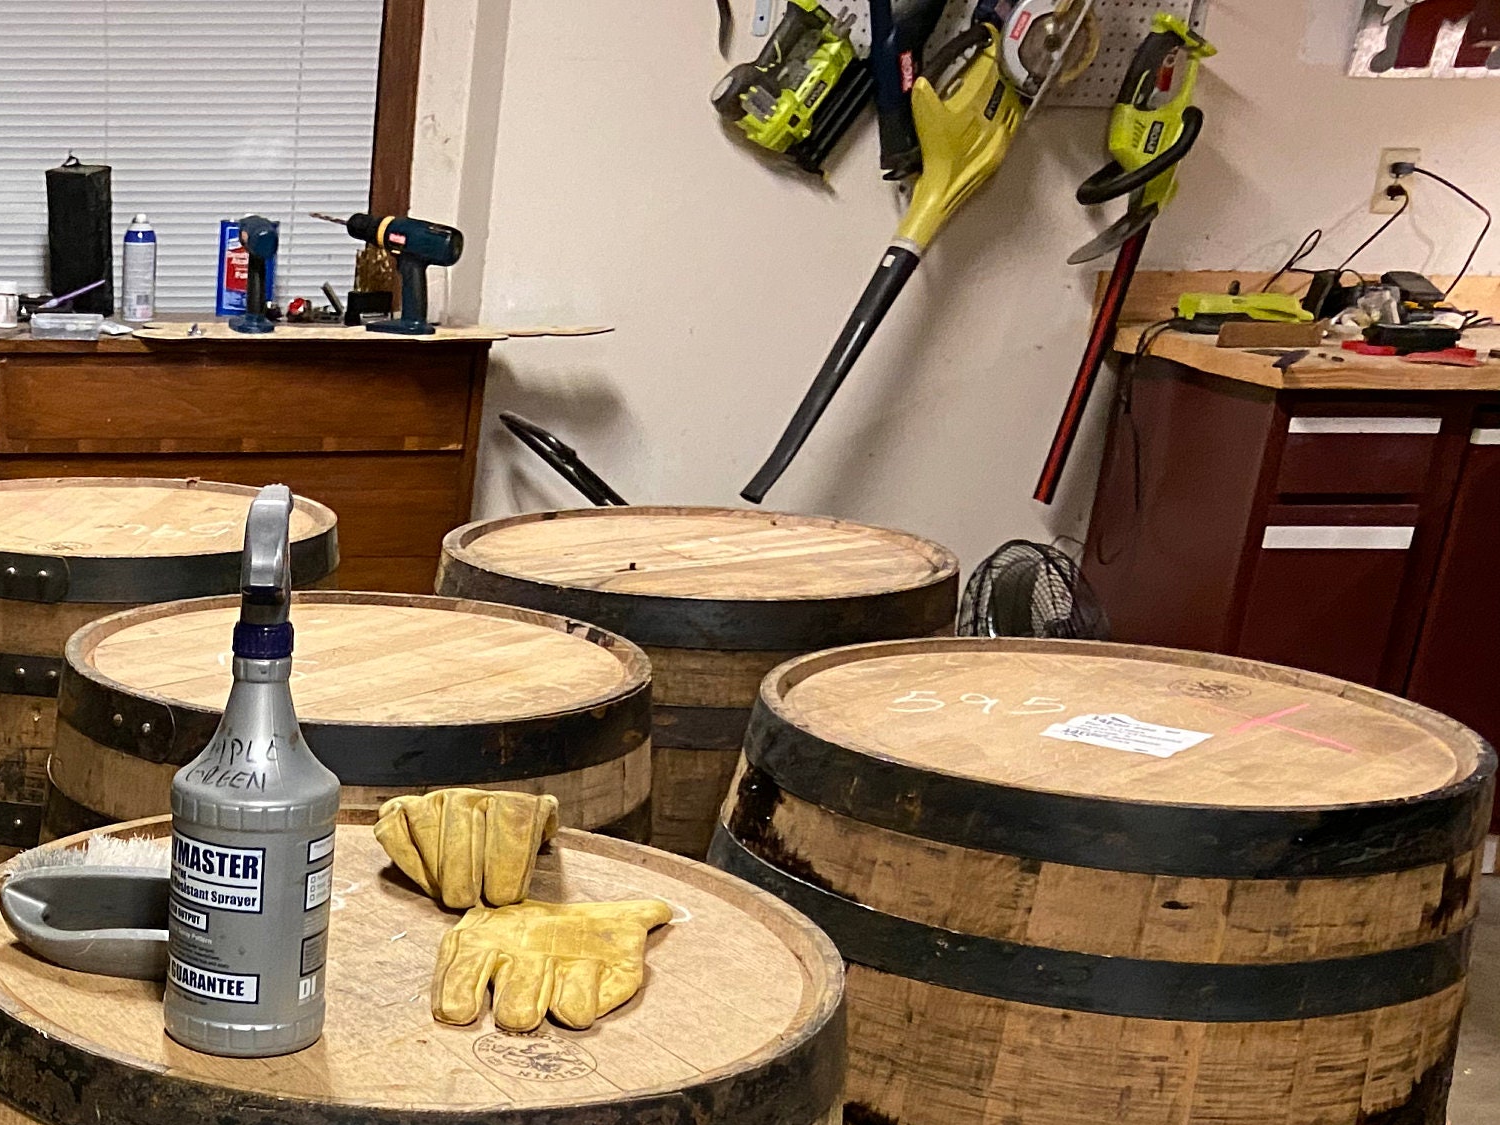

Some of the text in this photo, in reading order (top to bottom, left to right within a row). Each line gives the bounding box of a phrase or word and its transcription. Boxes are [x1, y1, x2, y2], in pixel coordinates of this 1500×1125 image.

[887, 690, 1067, 715] 595
[185, 757, 266, 793] GREEN
[211, 890, 257, 907] Sprayer
[172, 959, 244, 996] GUARANTEE
